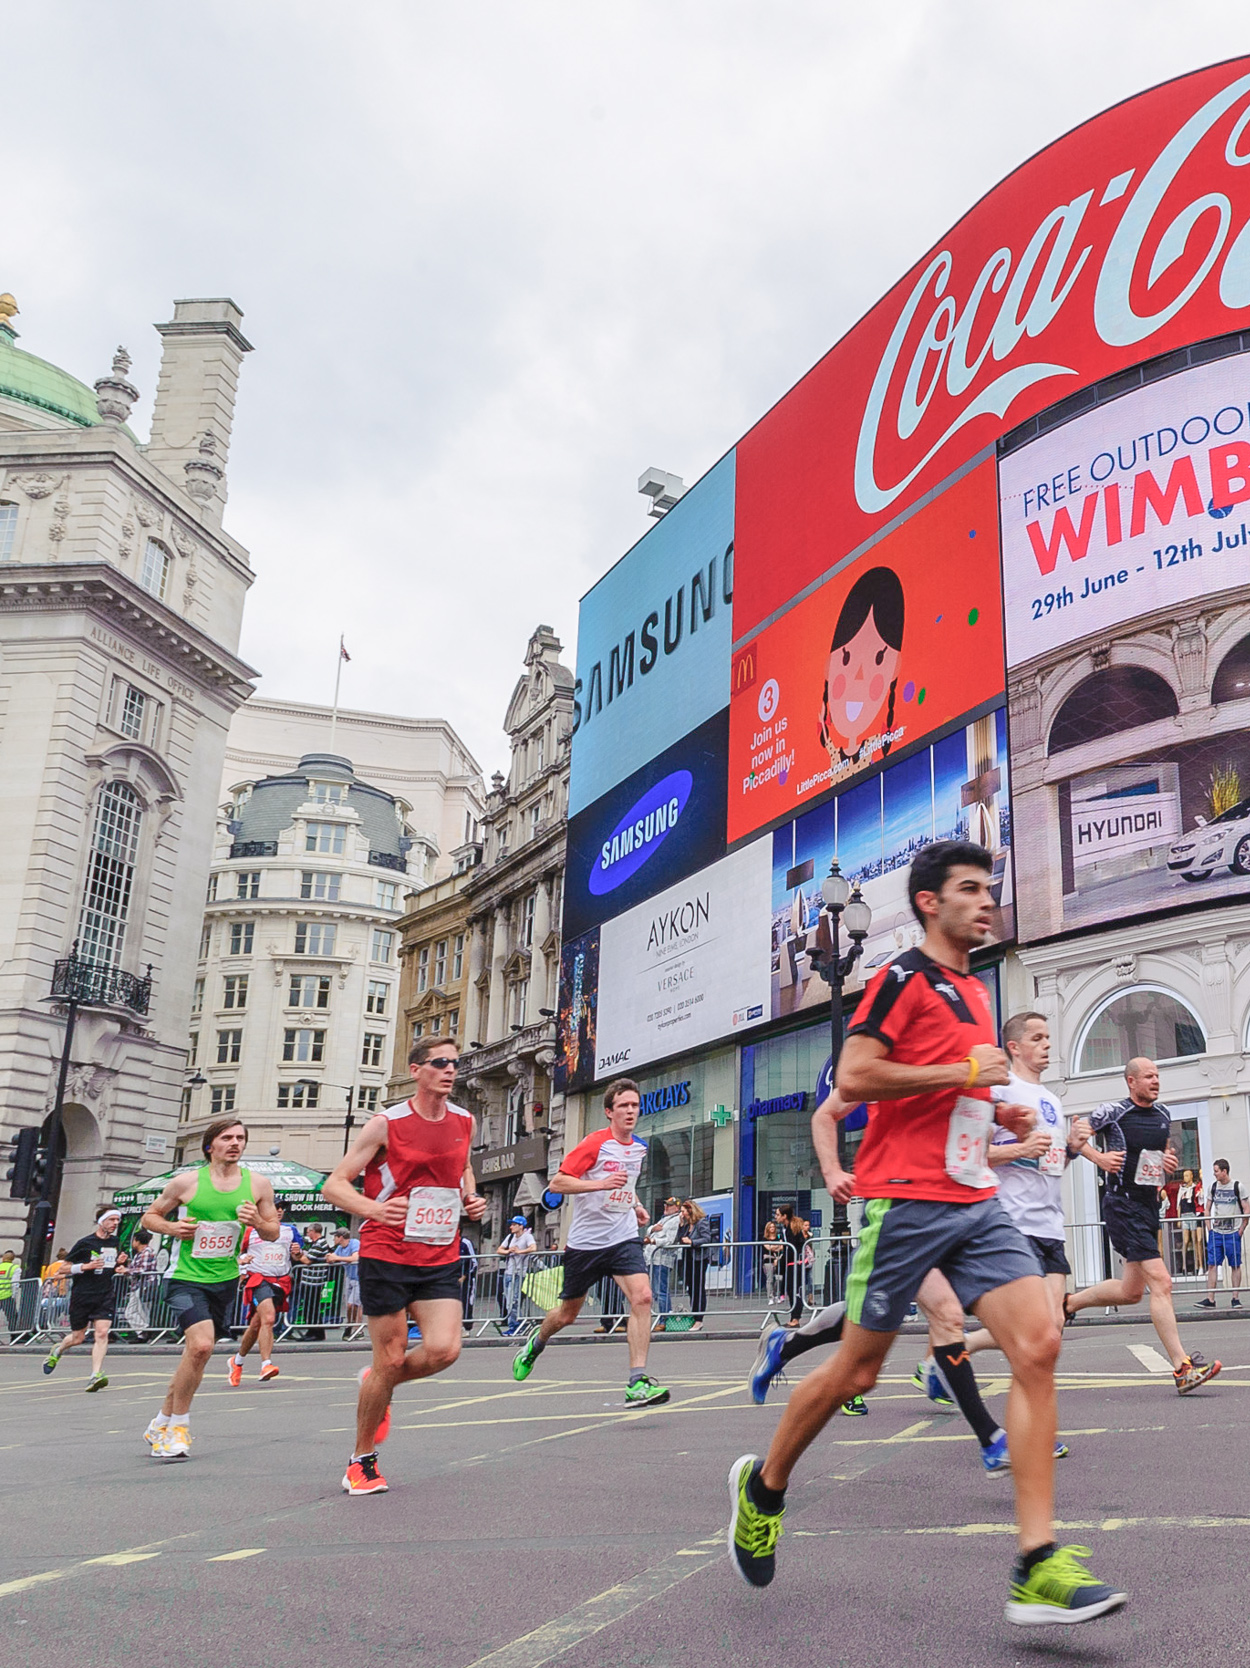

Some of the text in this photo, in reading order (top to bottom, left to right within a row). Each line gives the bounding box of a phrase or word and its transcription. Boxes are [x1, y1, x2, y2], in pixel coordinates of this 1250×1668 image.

[1024, 465, 1082, 517] FREE
[1031, 585, 1074, 621] 29th
[1080, 566, 1129, 602] June
[1152, 539, 1203, 572] 12th
[90, 626, 194, 702] ALLIANCE LIFE OFFICE
[750, 717, 788, 750] Join us
[858, 726, 904, 759] #LittlePicca
[751, 737, 786, 770] now in
[742, 749, 795, 795] Piccadilly!
[796, 757, 850, 795] LittlePicca.com
[601, 797, 679, 870] SAMSUNG
[1078, 810, 1162, 845] HYUNDAI
[647, 891, 710, 951] AYKON
[658, 966, 695, 992] VERSACE
[598, 1049, 631, 1070] DAMAC
[639, 1081, 692, 1117] ARCLAYS
[747, 1091, 807, 1122] pharmacy
[501, 1152, 516, 1170] BAR
[284, 1193, 306, 1202] SHOW
[291, 1203, 333, 1212] BOOK HERE
[608, 1190, 633, 1204] 4479
[414, 1207, 453, 1225] 5032
[199, 1235, 234, 1250] 8555
[264, 1253, 283, 1261] 5100
